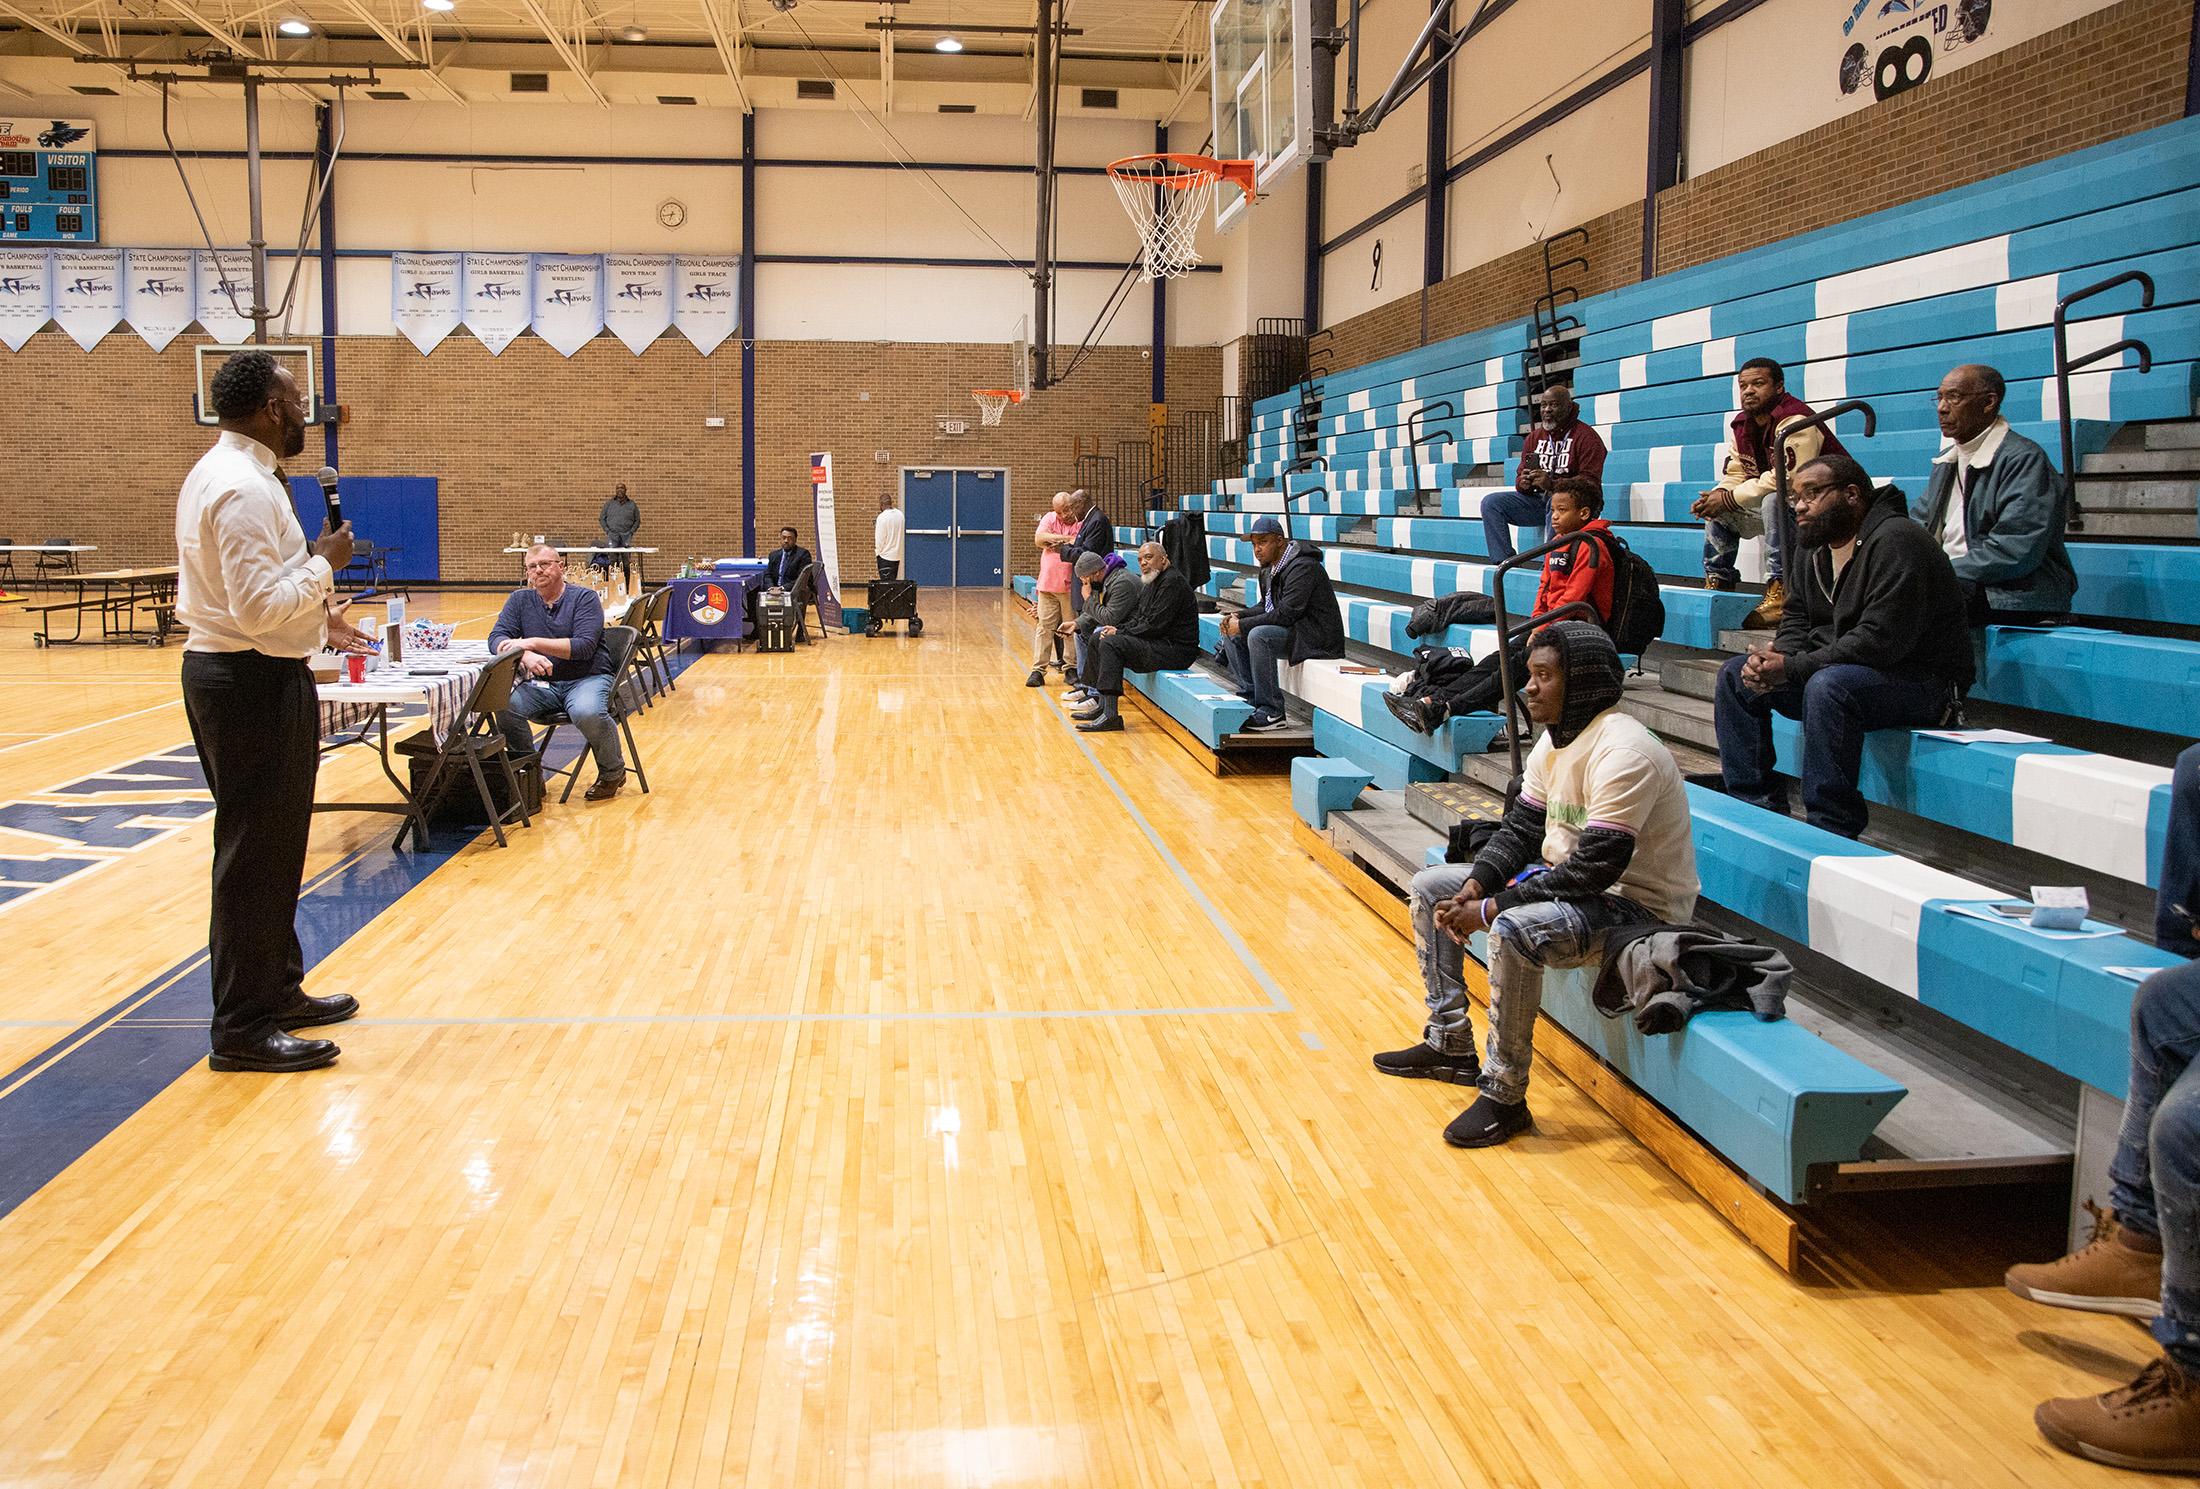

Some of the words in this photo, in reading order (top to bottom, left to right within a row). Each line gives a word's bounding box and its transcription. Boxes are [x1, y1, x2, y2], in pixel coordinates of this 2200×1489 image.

[47, 154, 86, 166] VISITOR
[11, 205, 33, 213] FOULS
[59, 206, 80, 214] FOULS
[7, 252, 49, 261] CHAMPIONSHIP
[54, 252, 81, 261] REGIONAL
[81, 253, 122, 261] CHAMPIONSHIP
[129, 253, 147, 262] STATE
[147, 253, 192, 263] CHAMPIONSHIP
[223, 254, 252, 263] CHAMPION
[395, 257, 421, 266] REGIONAL
[422, 258, 460, 267] CHAMPIONSHIP
[467, 257, 485, 266] STATE
[485, 257, 528, 267] CHAMPIONSHIP
[606, 258, 632, 267] REGIONAL
[632, 258, 673, 267] CHAMPIONSHIP
[675, 258, 701, 267] REGIONAL
[702, 259, 741, 268] CHAMPIONSHIP
[1371, 239, 1381, 291] 9
[535, 263, 559, 272] DISTRICT
[560, 263, 601, 273] CHAMPIONSHIP
[949, 422, 962, 432] EXIT
[702, 607, 715, 620] G
